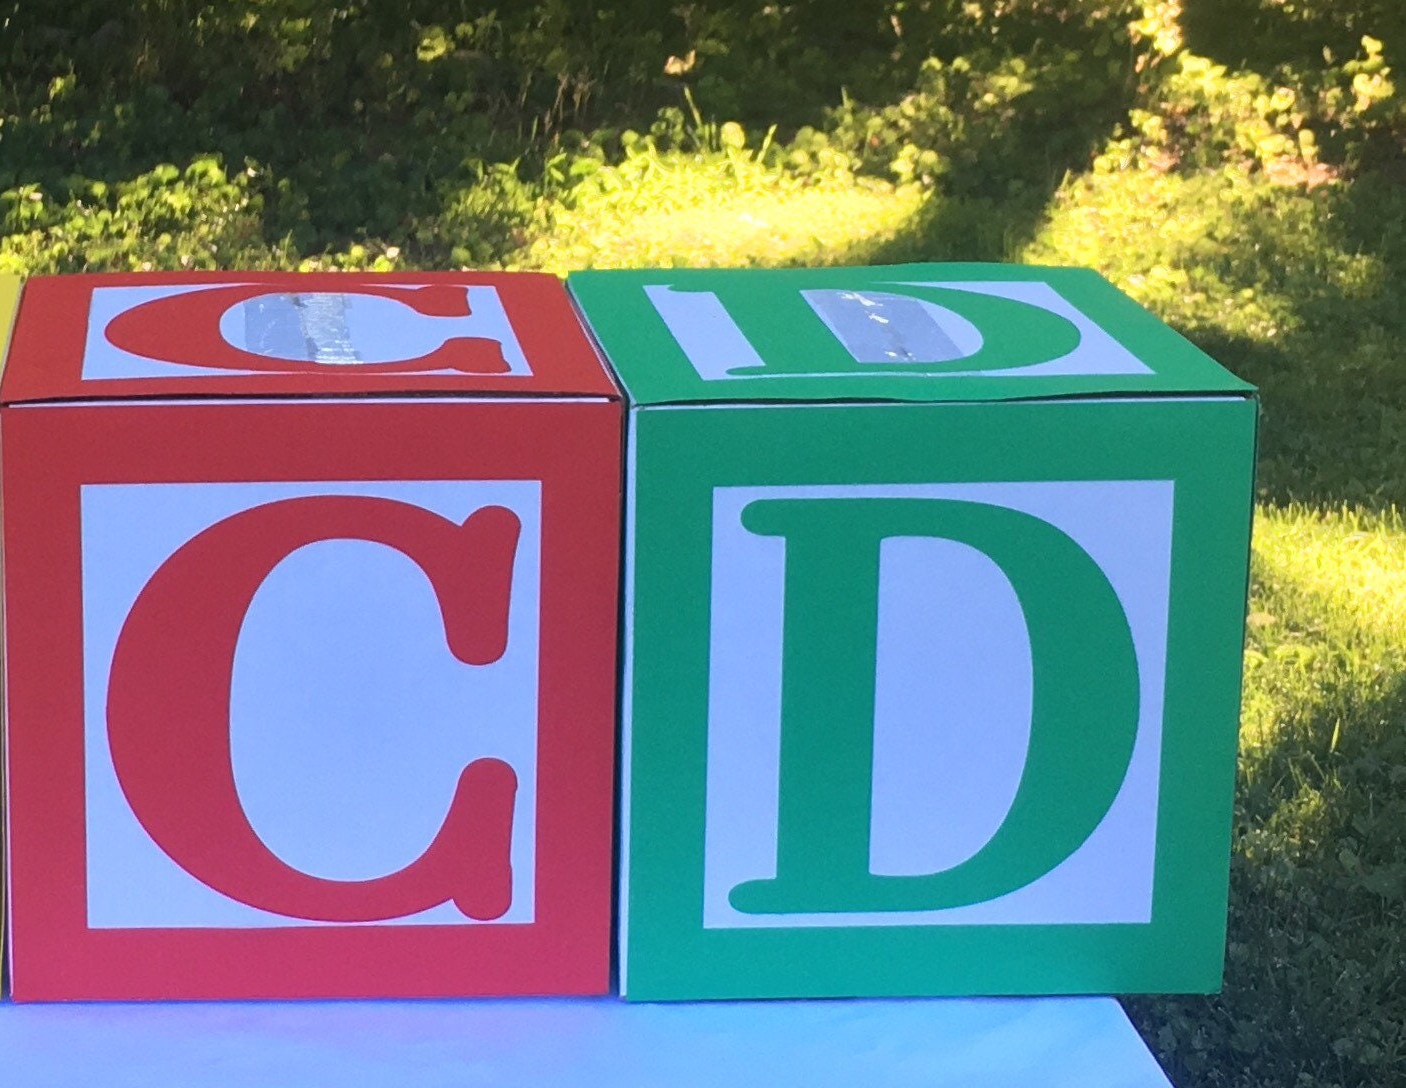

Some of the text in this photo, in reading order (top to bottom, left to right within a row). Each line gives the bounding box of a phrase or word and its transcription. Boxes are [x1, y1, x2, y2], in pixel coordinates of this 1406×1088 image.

[104, 283, 512, 374] C
[667, 282, 1082, 376] D
[105, 494, 522, 922] C
[728, 497, 1141, 915] D
